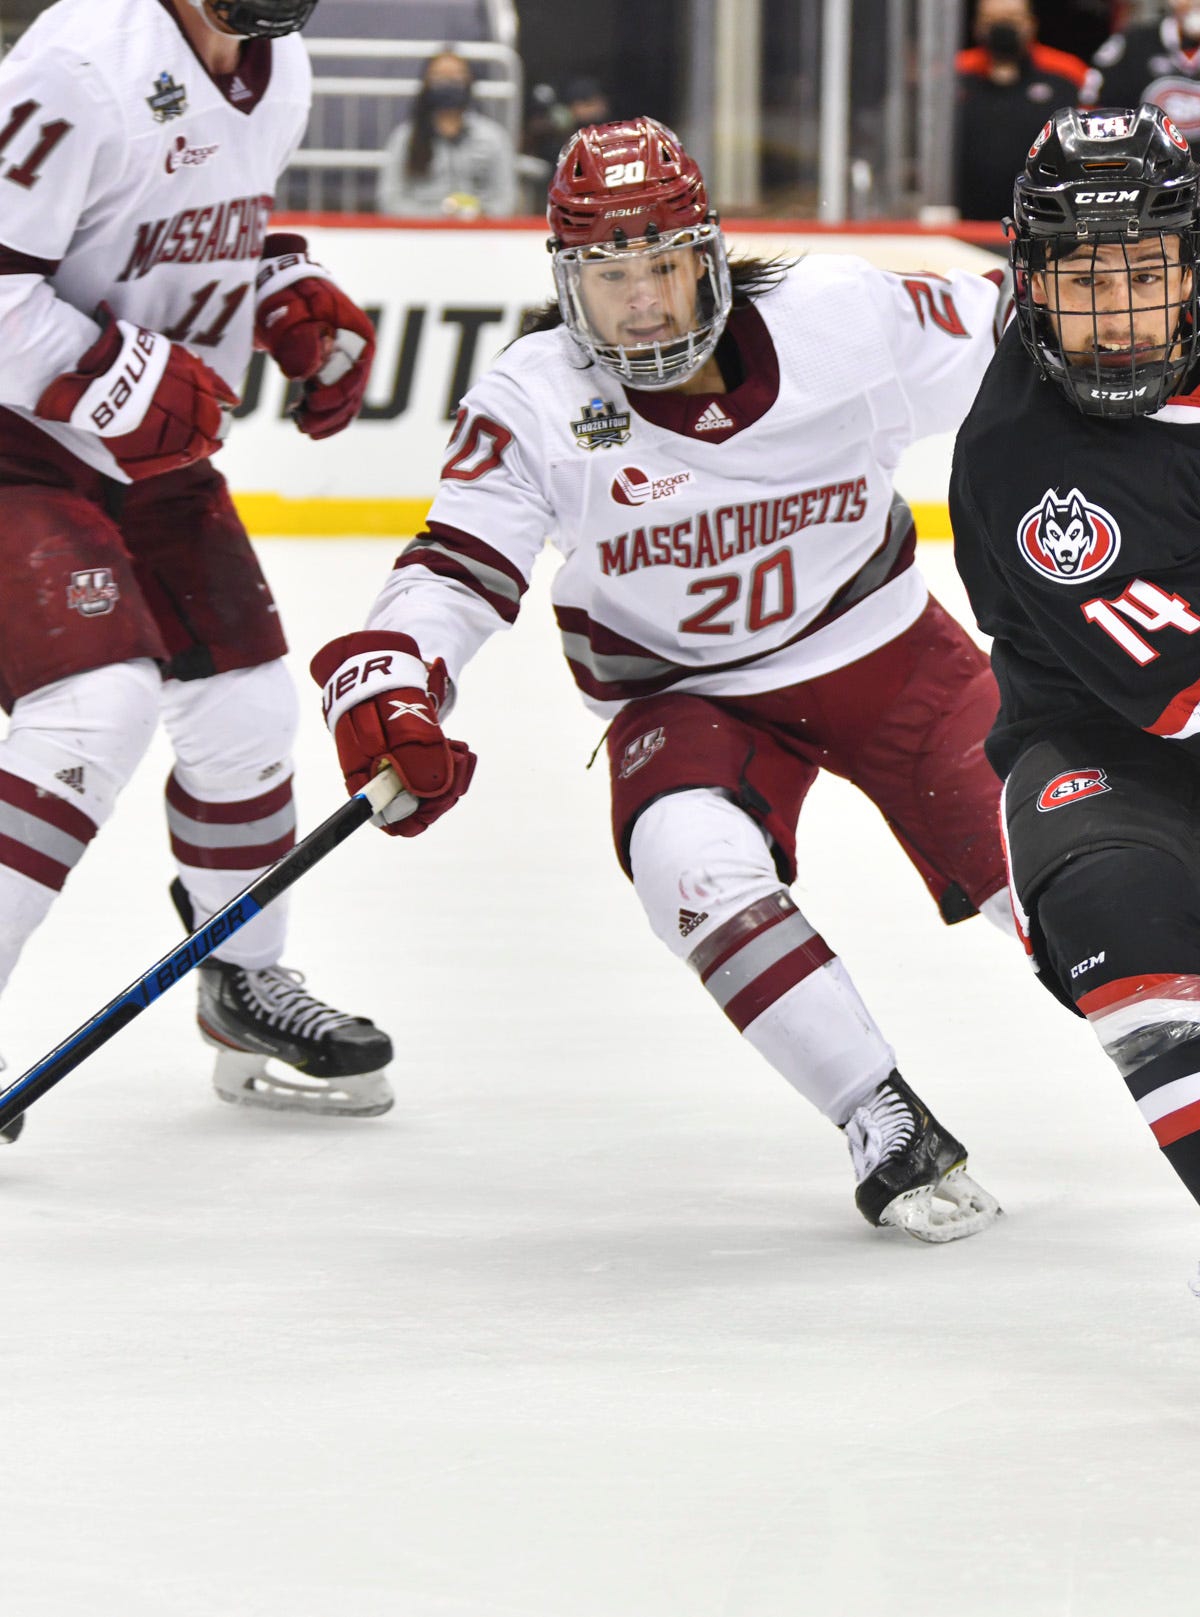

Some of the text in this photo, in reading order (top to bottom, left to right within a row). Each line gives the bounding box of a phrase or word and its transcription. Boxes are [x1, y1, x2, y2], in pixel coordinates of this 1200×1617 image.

[605, 160, 645, 188] 20
[1074, 190, 1140, 204] CCM
[162, 280, 251, 347] 11
[576, 415, 628, 435] FROZEN FOUR
[695, 418, 734, 432] adidas
[651, 472, 691, 490] HOCKEY
[652, 487, 677, 500] EAST
[597, 476, 869, 577] MASSACHUSETTS
[678, 546, 797, 636] 20
[322, 656, 393, 718] UER
[681, 911, 709, 937] adidas
[157, 904, 246, 990] BAUER
[1070, 951, 1105, 979] CCM
